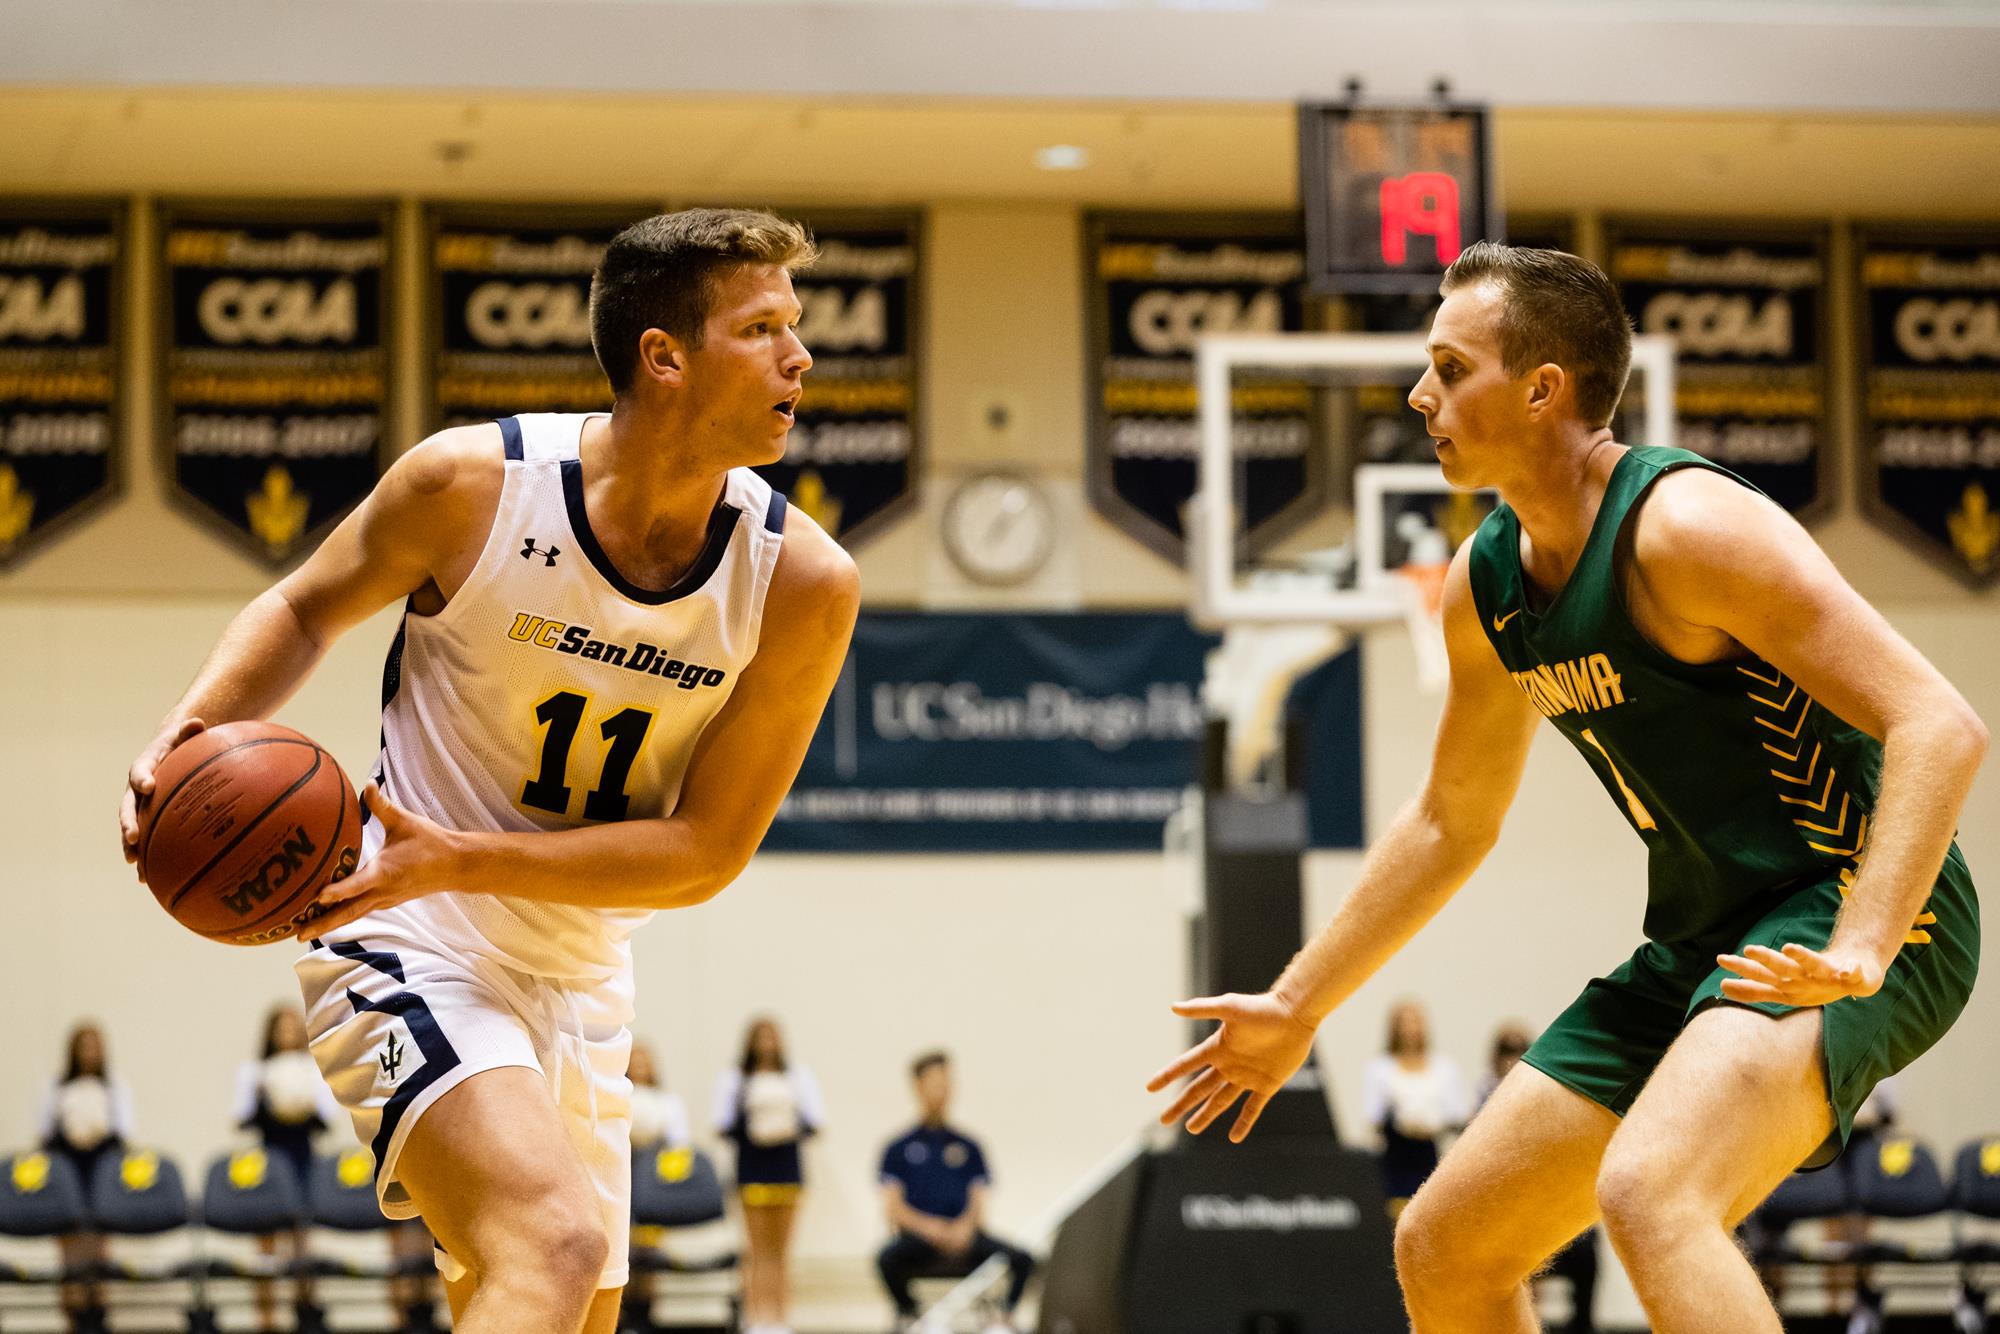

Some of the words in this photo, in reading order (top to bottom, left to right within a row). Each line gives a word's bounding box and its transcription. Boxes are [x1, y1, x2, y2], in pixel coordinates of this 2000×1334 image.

[1380, 172, 1461, 266] 19
[200, 278, 358, 344] CCAA
[467, 282, 592, 347] CCA
[872, 682, 942, 741] UC
[518, 688, 657, 823] 11
[221, 825, 317, 917] NCAA
